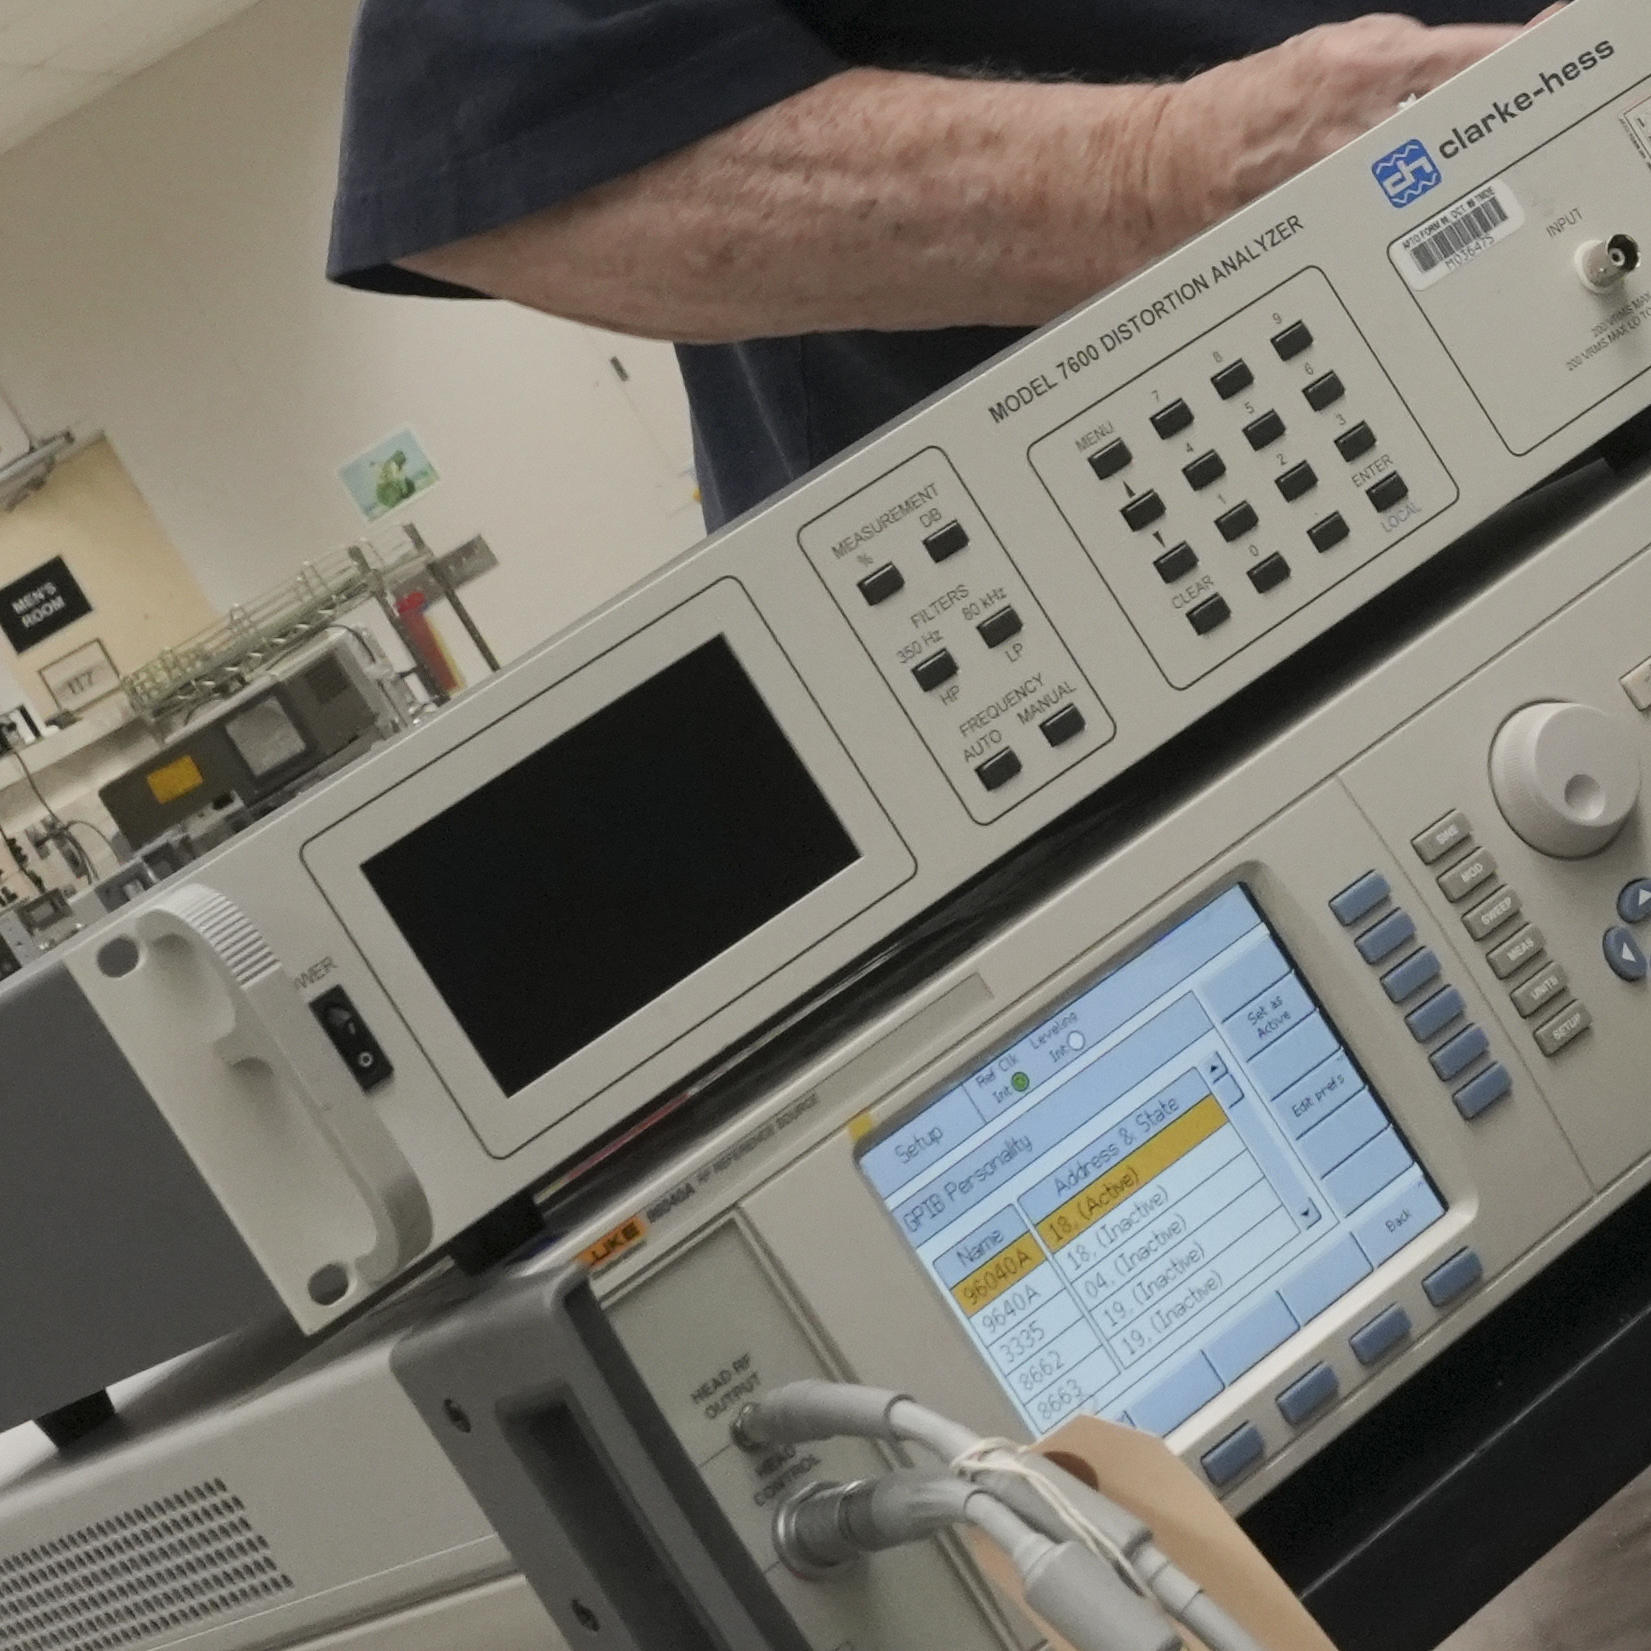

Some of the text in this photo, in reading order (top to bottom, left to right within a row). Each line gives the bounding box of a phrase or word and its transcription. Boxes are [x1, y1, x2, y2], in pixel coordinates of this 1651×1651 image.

[1431, 33, 1618, 161] clarke-hess
[1544, 207, 1584, 238] INPUT
[1443, 233, 1496, 270] M036475
[986, 212, 1306, 424] MODEL 7600 DISTORTION ANALYZER
[1073, 419, 1116, 454] MENU
[1348, 452, 1395, 489] ENTER
[828, 481, 942, 560] MEASUREMENT
[917, 505, 944, 529] DB
[1378, 498, 1423, 534] LOCAL
[20, 594, 66, 628] ROOM
[908, 582, 972, 630] FILTERS
[976, 584, 1008, 612] kHz
[1168, 573, 1216, 611] CLEAR
[893, 625, 944, 665] 350 Hz
[1003, 640, 1028, 664] LP
[937, 683, 964, 707] HP
[955, 672, 1049, 738] FREQUENCY
[1014, 677, 1078, 726] MANUAL
[959, 726, 1005, 763] AUTO
[1460, 861, 1485, 883] MOD
[1479, 896, 1515, 926] SWEEP
[1506, 937, 1535, 961] MEAS
[290, 953, 339, 991] WER
[1529, 974, 1560, 1000] UNITS
[1245, 994, 1285, 1026] Set as
[1253, 1007, 1292, 1040] Active
[1550, 1012, 1584, 1040] SETUP
[1289, 1071, 1348, 1118] Edit prefs
[892, 1121, 947, 1166] Setup
[1049, 1092, 1180, 1196] Address & State
[900, 1128, 1035, 1235] GPIB Personality
[1073, 1163, 1142, 1221] (Active)
[1091, 1183, 1172, 1250] (Inactive)
[1383, 1206, 1414, 1233] Back
[954, 1224, 1005, 1268] Name
[1109, 1211, 1191, 1278] (Inactive)
[959, 1244, 1033, 1305] 96040A
[1128, 1240, 1209, 1306] (Inactive)
[978, 1280, 1042, 1335] 9640A
[1145, 1267, 1227, 1335] (Inactive)
[996, 1319, 1047, 1364] 3335
[1015, 1348, 1067, 1393] 8662
[1034, 1376, 1086, 1422] 8663
